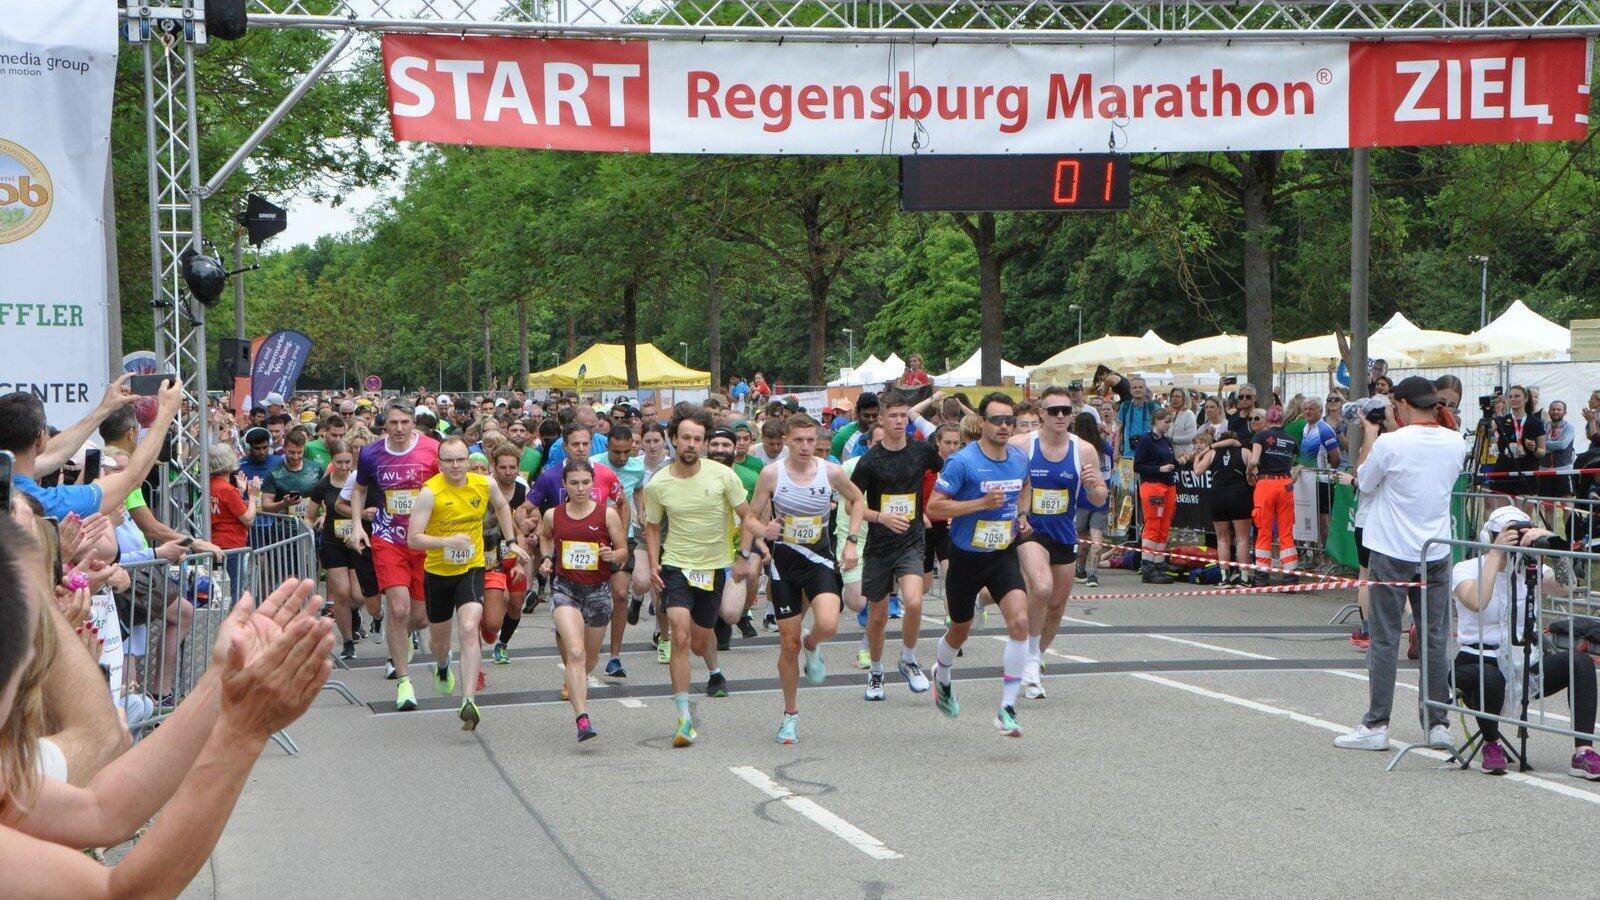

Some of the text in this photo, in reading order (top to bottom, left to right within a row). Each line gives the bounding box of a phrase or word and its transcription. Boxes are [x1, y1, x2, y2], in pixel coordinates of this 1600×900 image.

[389, 56, 641, 127] START
[1394, 57, 1553, 125] ZIEL
[688, 71, 1028, 133] Regensburg
[382, 472, 403, 480] AVL
[393, 500, 413, 509] 7062
[1041, 500, 1060, 509] 8621
[793, 529, 814, 539] 7420
[983, 532, 1004, 544] 7050
[451, 549, 470, 559] 7440
[570, 553, 591, 564] 7422
